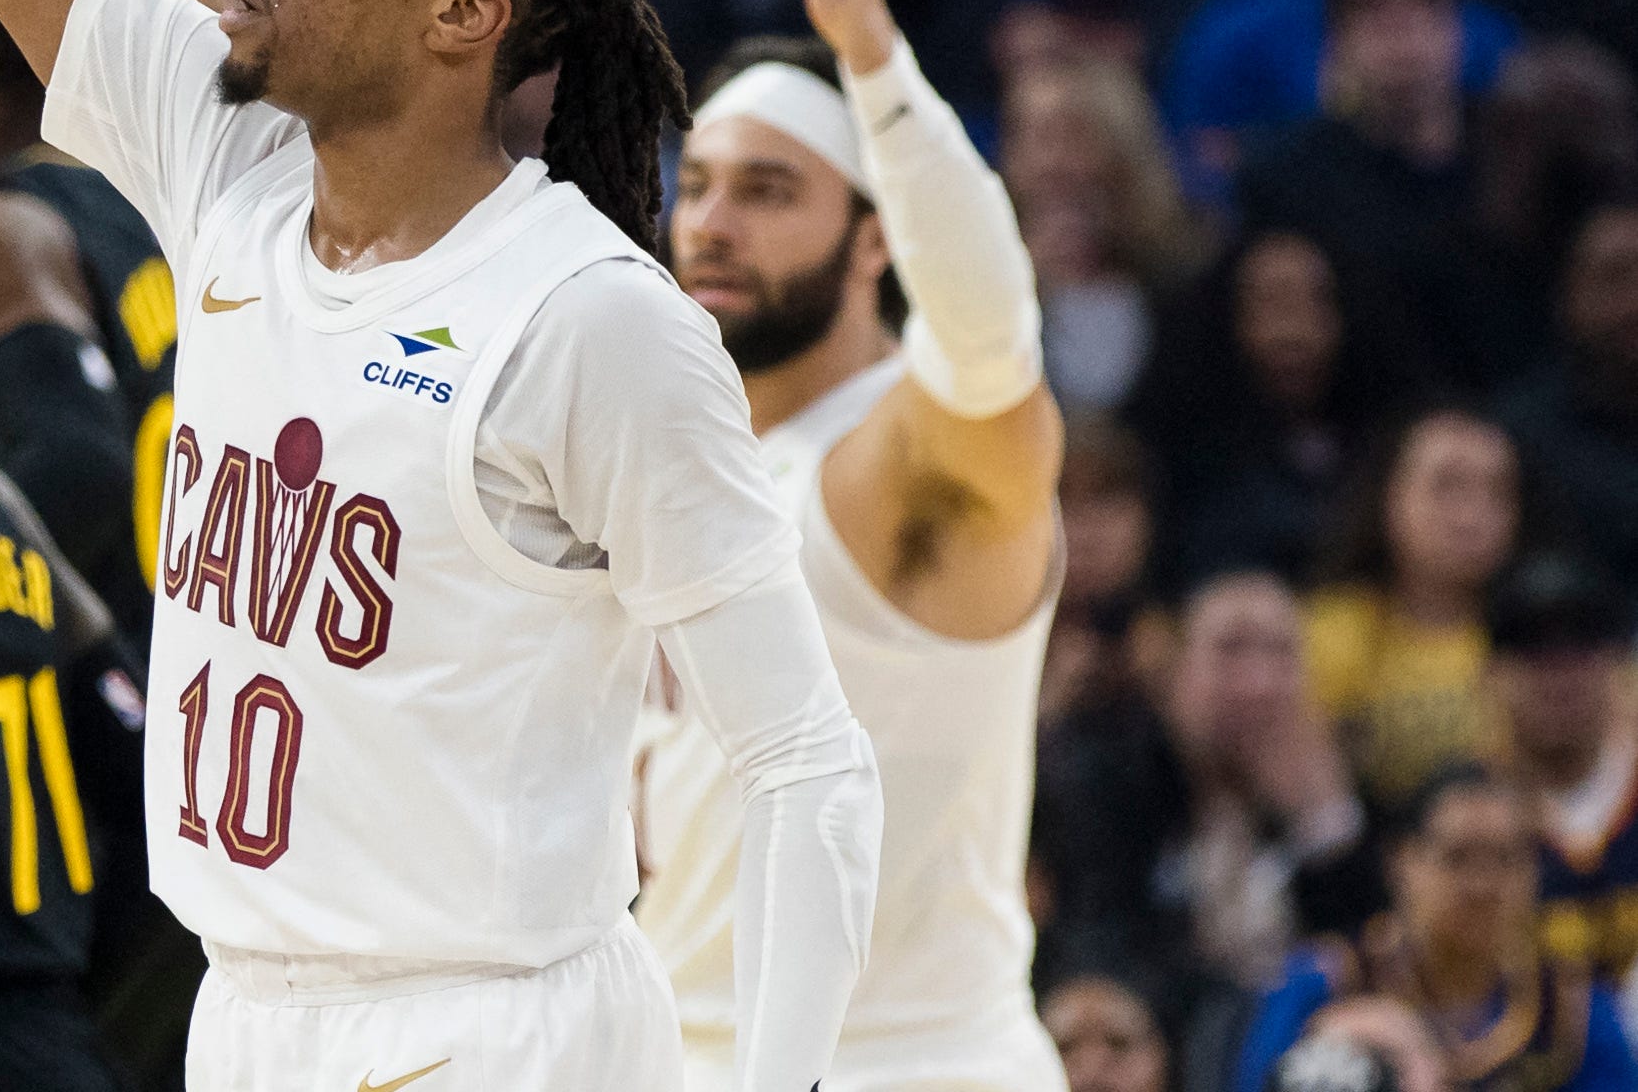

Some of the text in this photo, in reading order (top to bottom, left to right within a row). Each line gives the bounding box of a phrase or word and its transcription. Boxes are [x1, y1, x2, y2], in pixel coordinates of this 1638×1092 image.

[363, 361, 453, 404] CLIFFS
[163, 423, 403, 671] CAVS
[178, 659, 304, 871] 10
